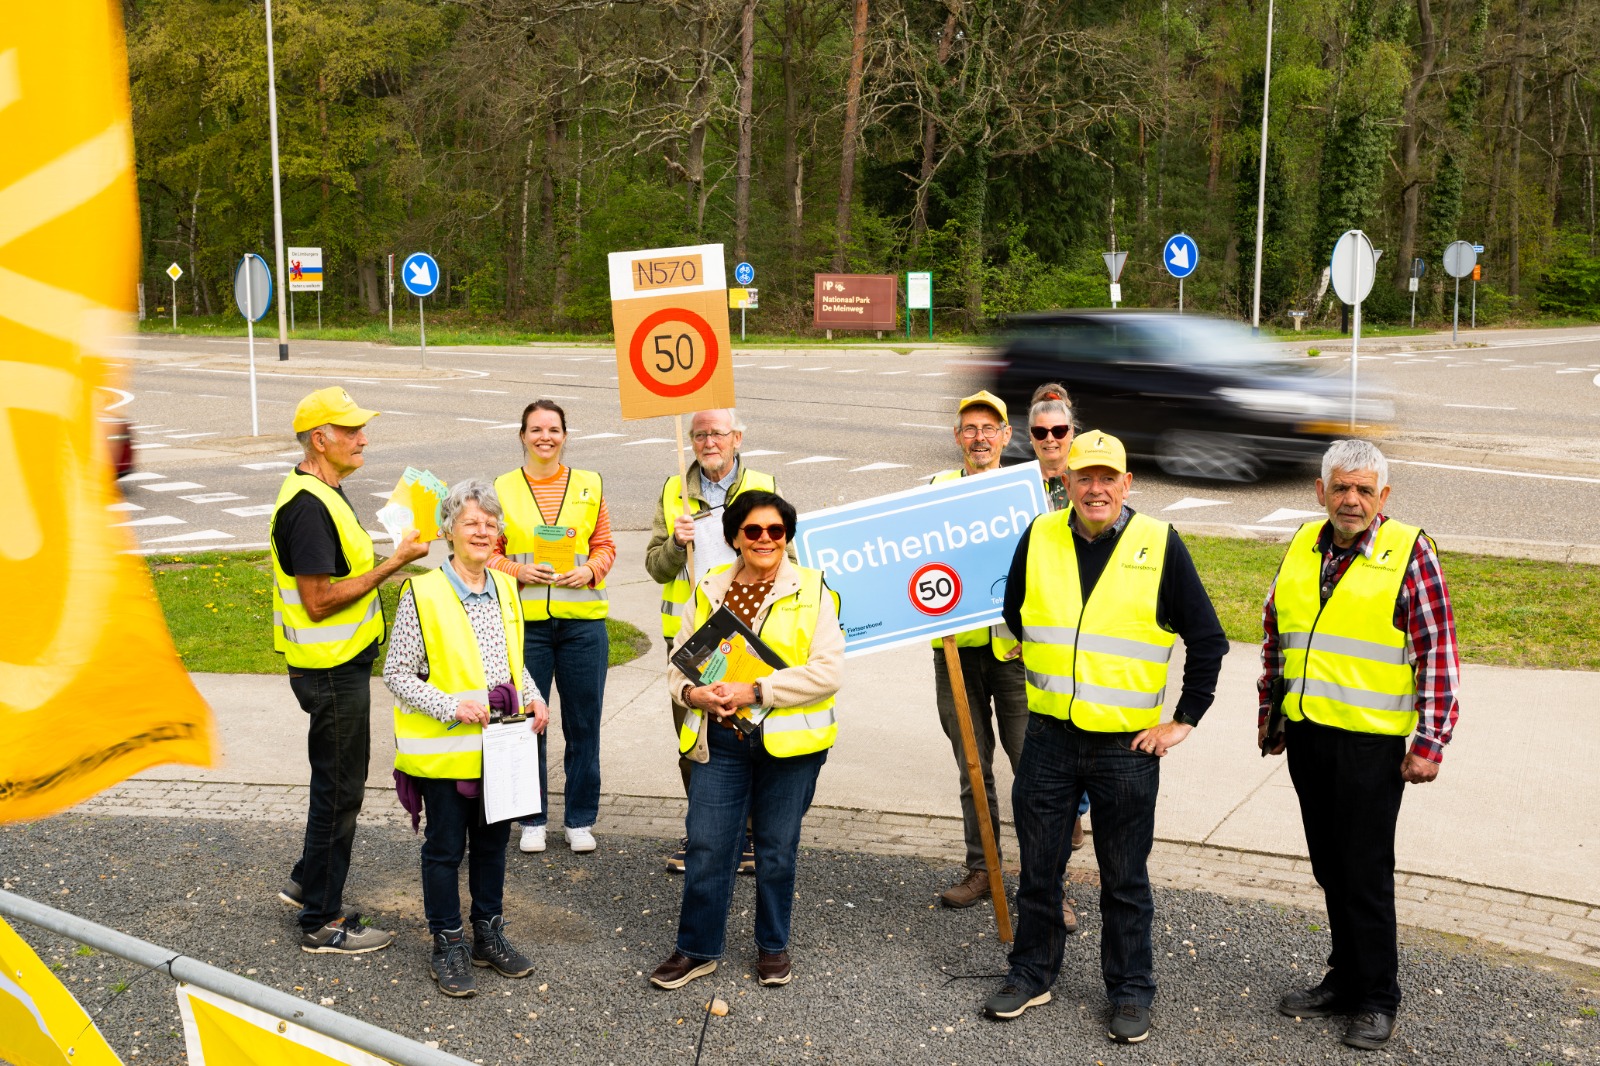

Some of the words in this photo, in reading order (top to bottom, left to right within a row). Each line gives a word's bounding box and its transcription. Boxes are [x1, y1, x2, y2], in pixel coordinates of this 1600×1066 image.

[638, 260, 696, 286] N570
[833, 305, 864, 314] Meinweg
[654, 334, 694, 373] 50
[816, 506, 1030, 578] Rothenbach
[919, 577, 952, 602] 50
[847, 621, 882, 633] Fietsersbond
